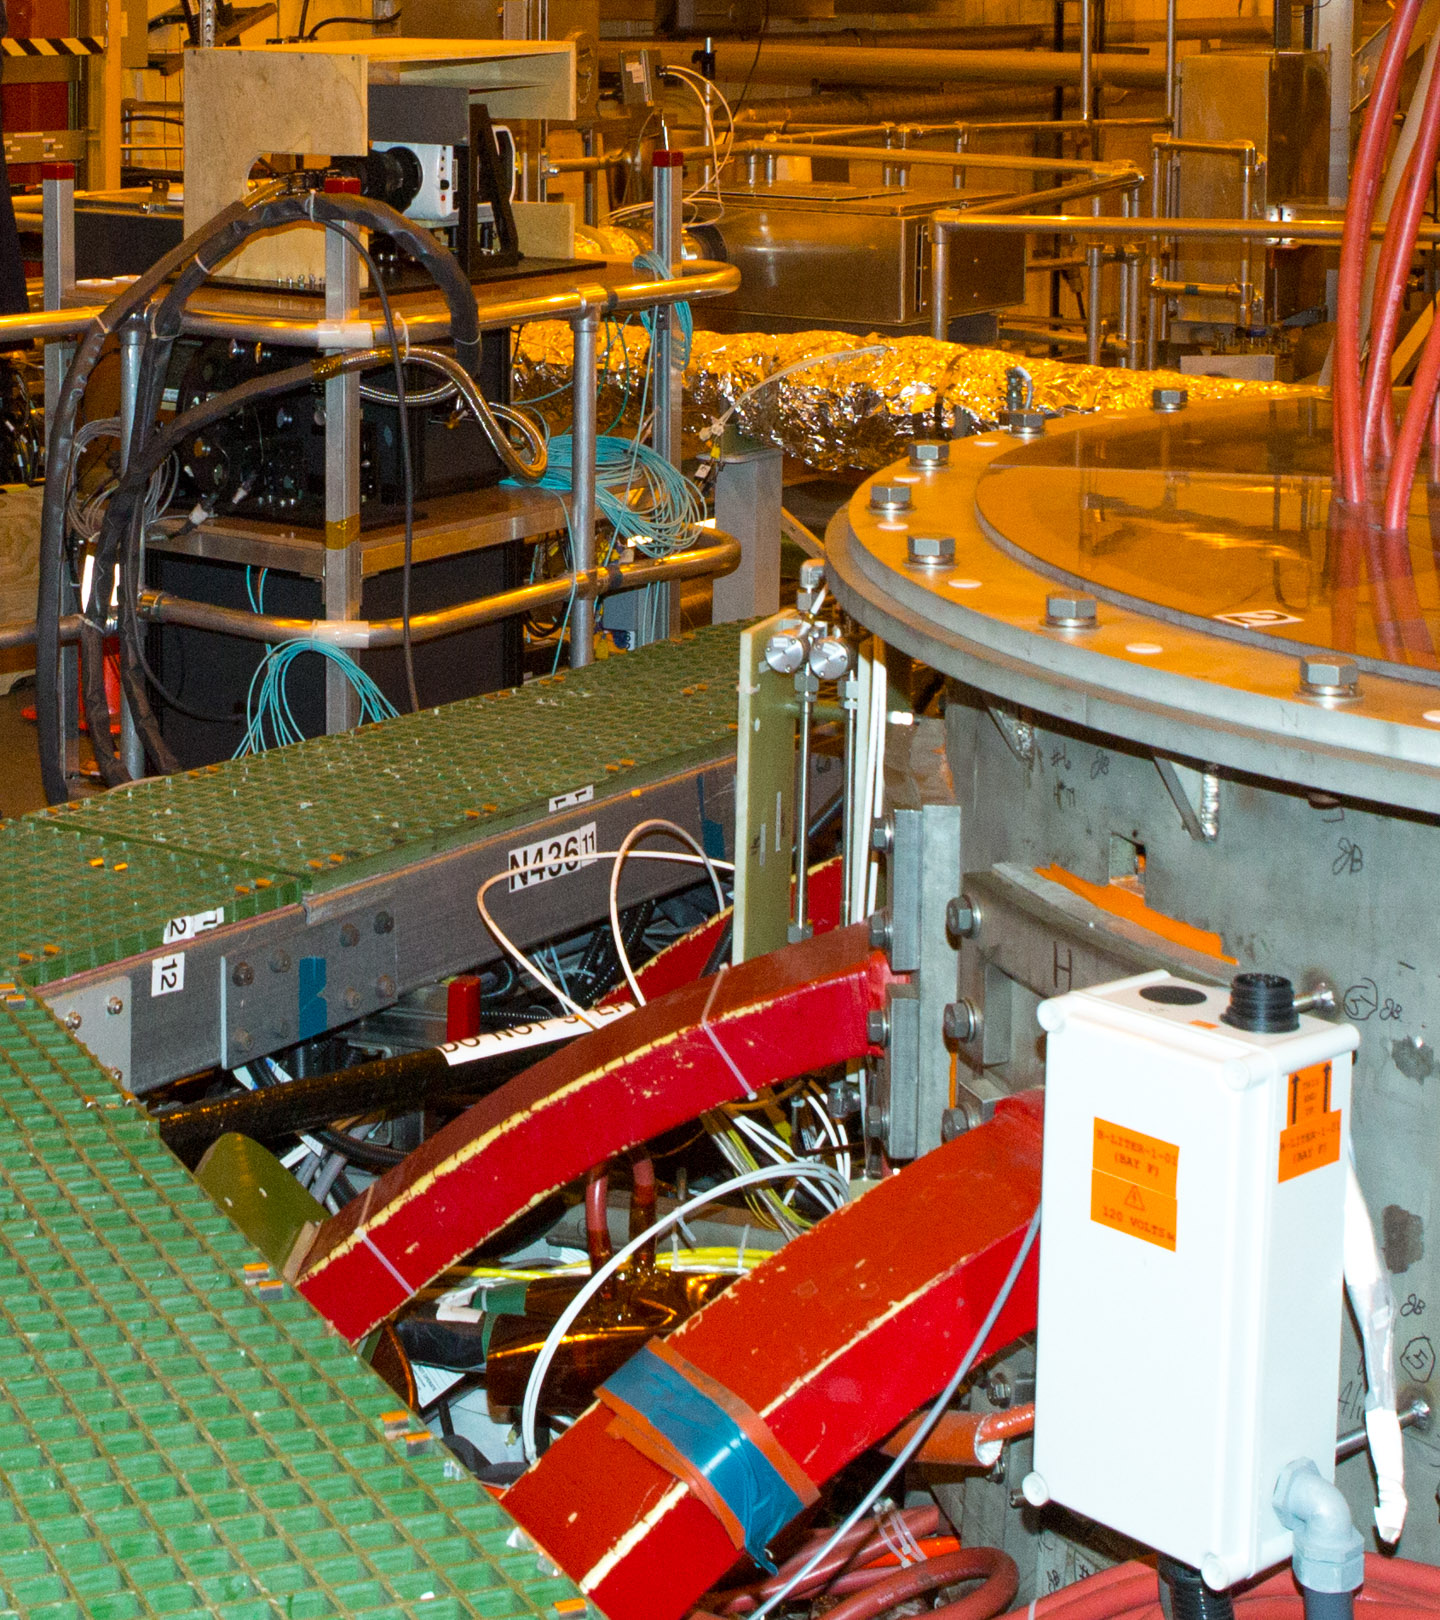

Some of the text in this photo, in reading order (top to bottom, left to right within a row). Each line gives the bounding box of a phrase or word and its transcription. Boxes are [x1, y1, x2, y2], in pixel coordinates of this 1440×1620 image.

[510, 836, 580, 890] N436
[160, 958, 178, 991] 12
[1053, 941, 1073, 992] H
[1103, 1206, 1124, 1222] 120
